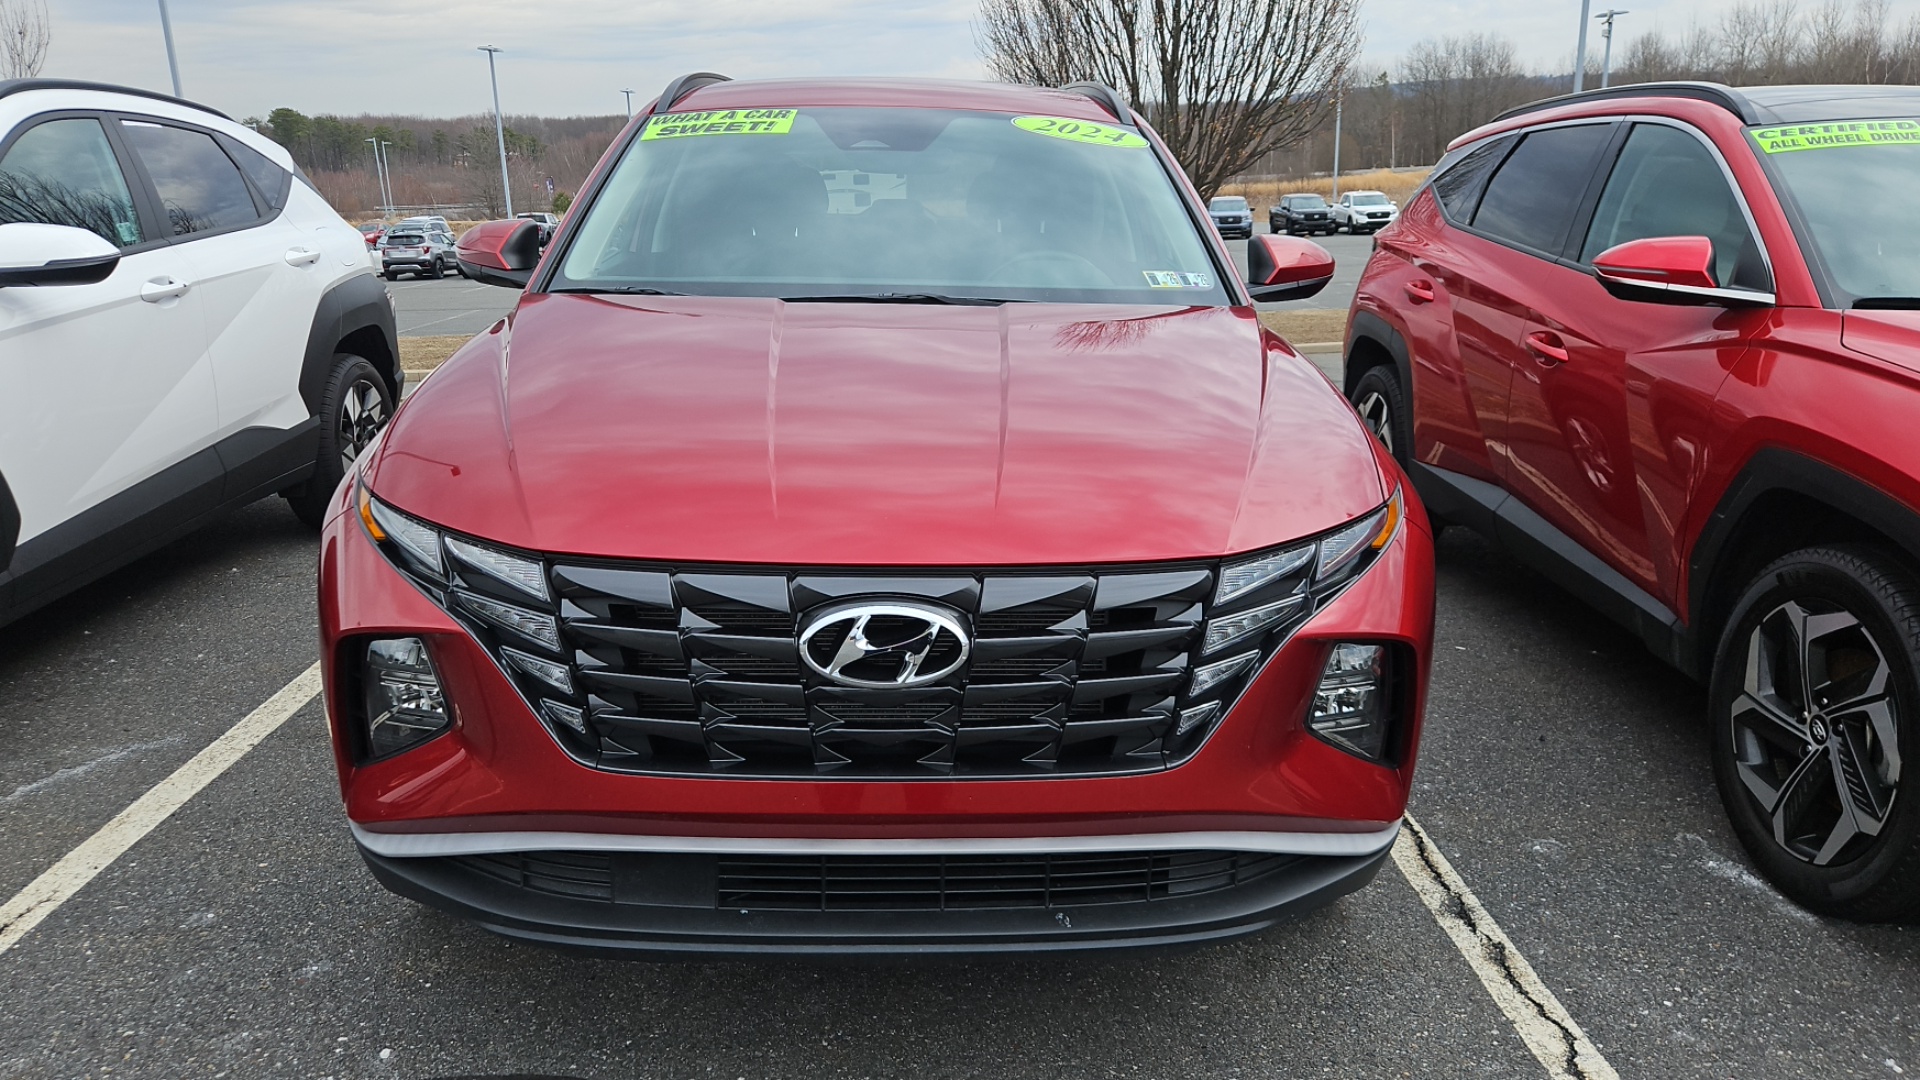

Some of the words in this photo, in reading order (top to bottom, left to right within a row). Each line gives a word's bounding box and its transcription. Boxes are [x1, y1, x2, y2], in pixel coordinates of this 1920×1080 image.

[652, 111, 719, 126] WHAT
[720, 110, 739, 120] A
[743, 109, 792, 119] CAR
[656, 121, 776, 136] SWEET!
[1033, 119, 1128, 142] 2024
[1757, 121, 1918, 140] CERTIFIED
[1769, 138, 1802, 150] ALL
[1805, 133, 1867, 145] WHEEL
[1871, 131, 1920, 142] DRIVE
